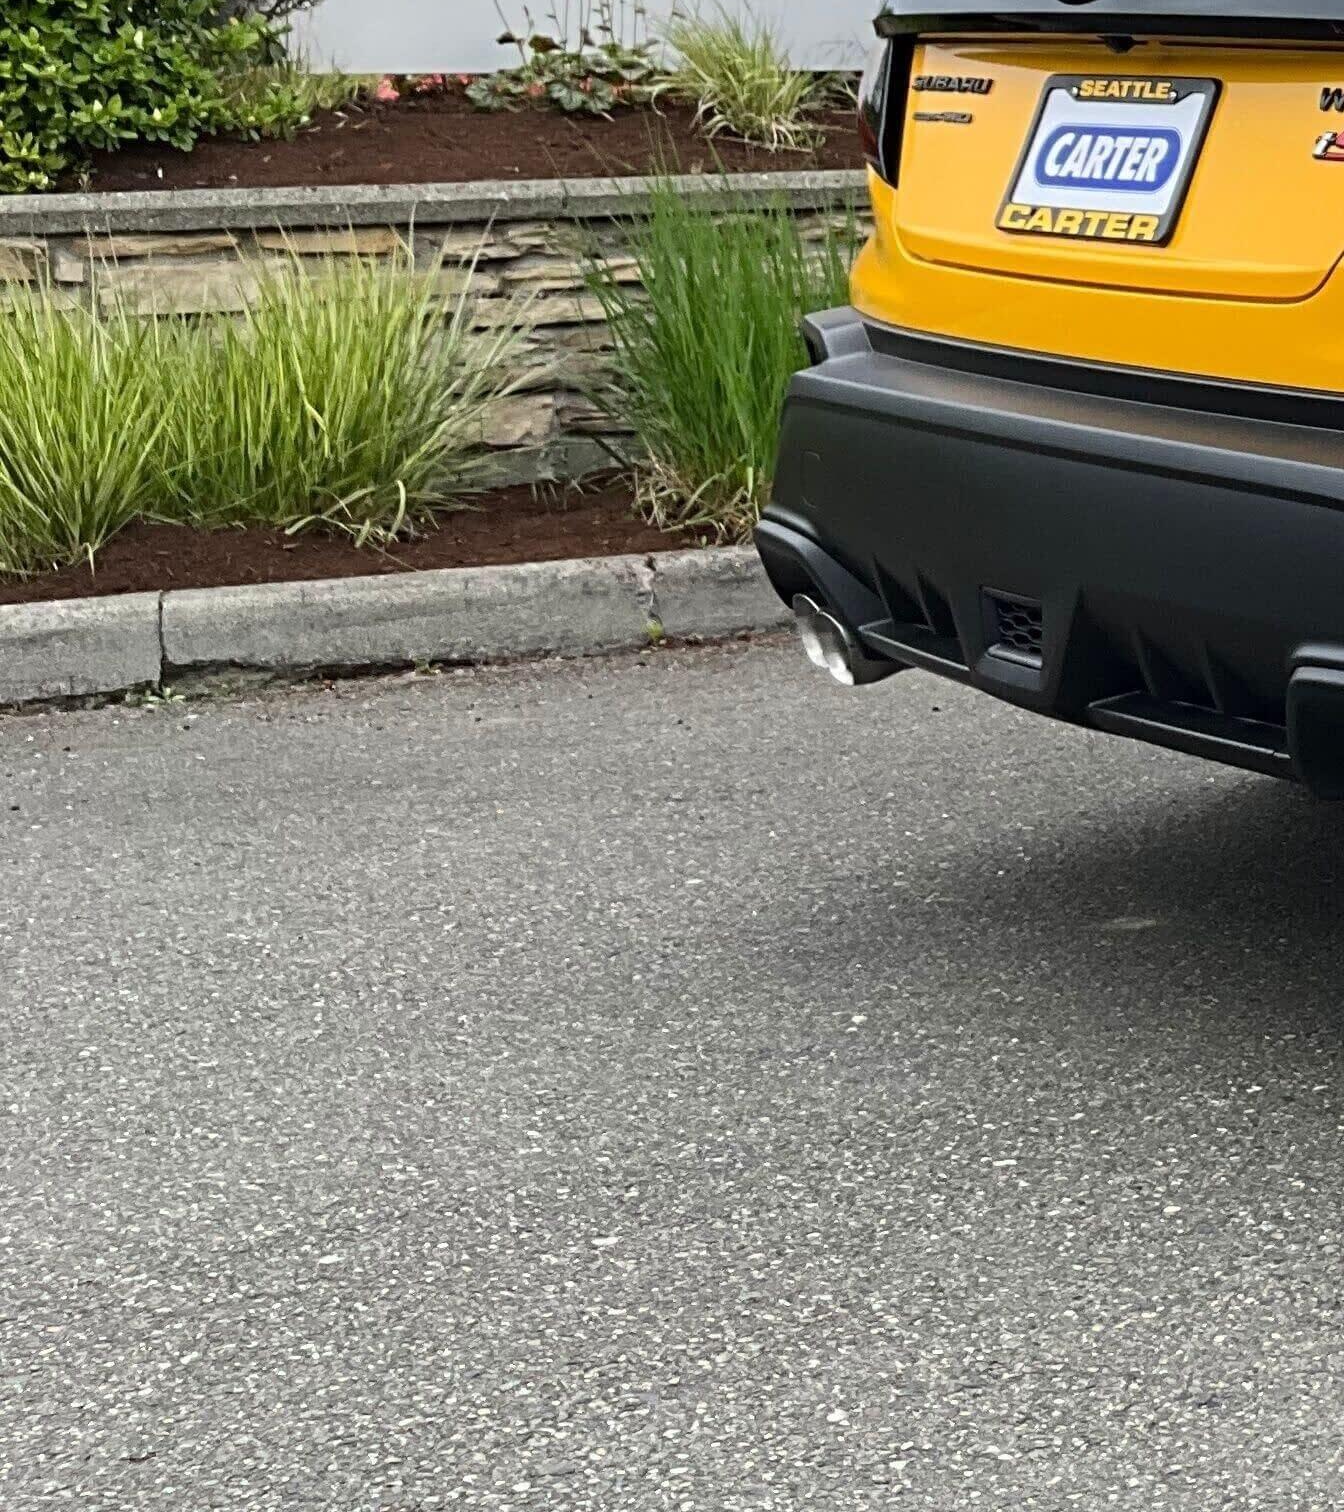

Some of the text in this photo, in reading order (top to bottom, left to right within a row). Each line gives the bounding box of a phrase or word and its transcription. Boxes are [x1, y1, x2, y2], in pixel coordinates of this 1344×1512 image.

[1079, 79, 1172, 100] SEATTLE
[1043, 131, 1169, 183] CARTER
[998, 203, 1159, 241] CARTER
